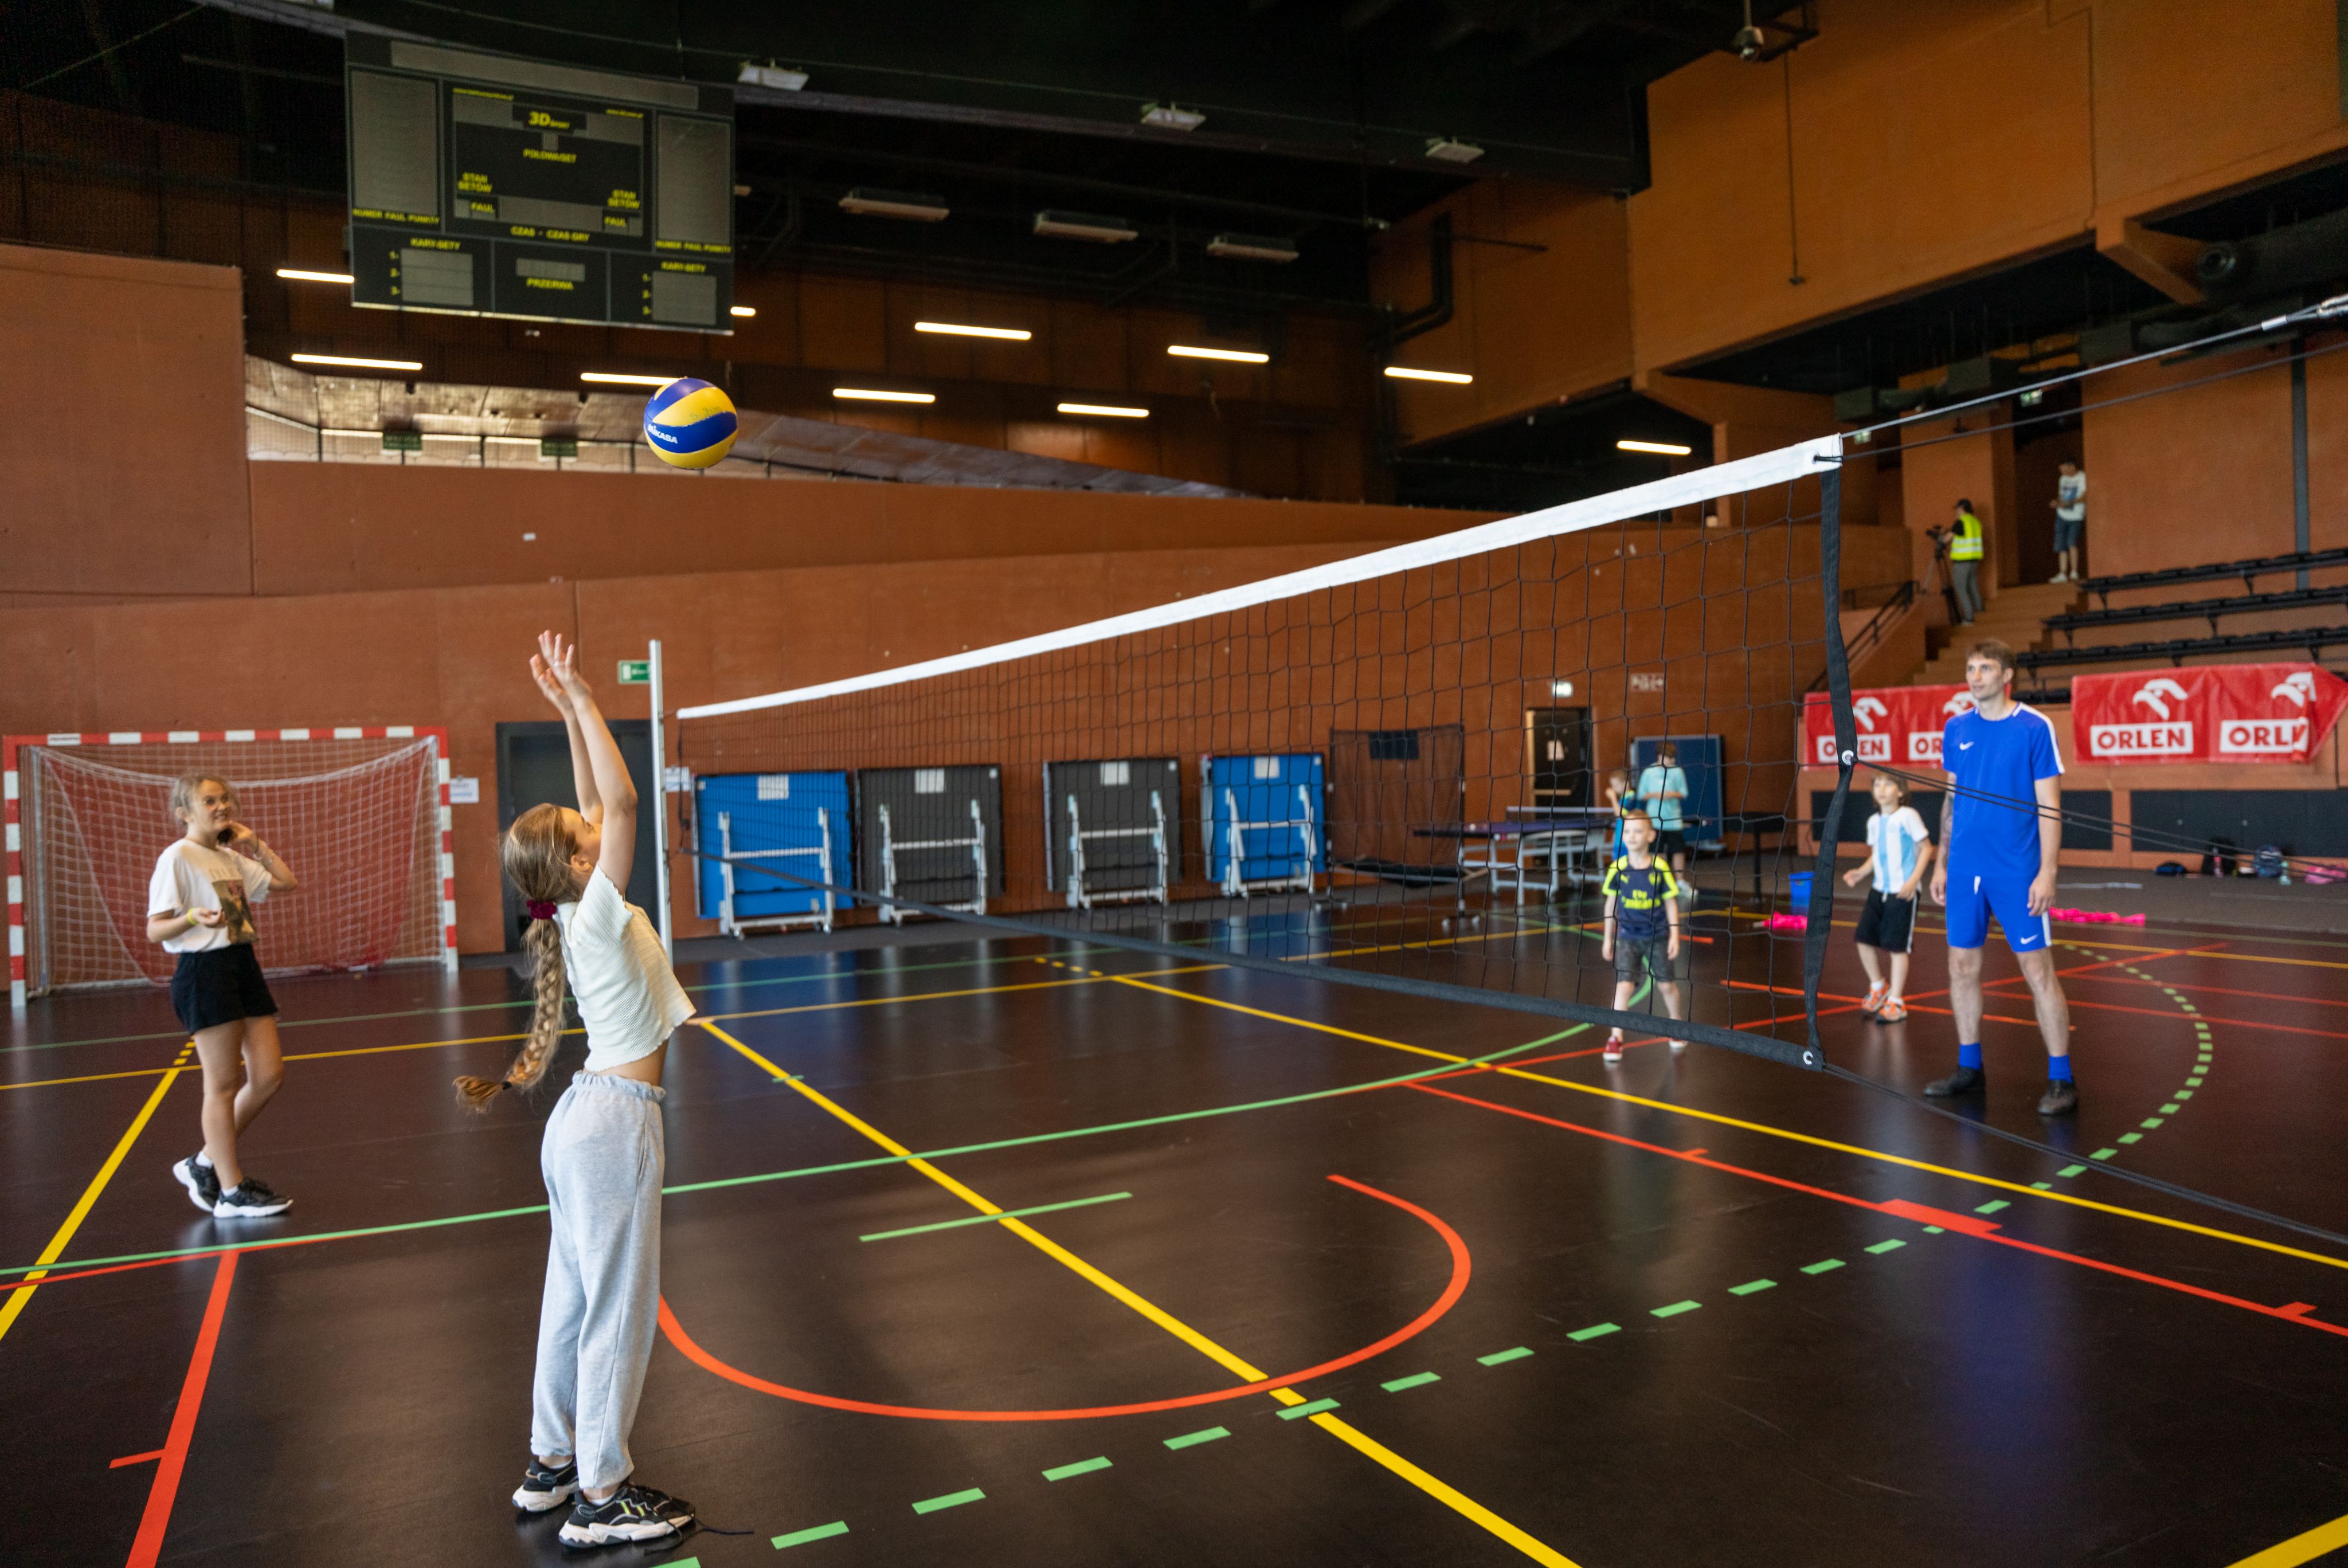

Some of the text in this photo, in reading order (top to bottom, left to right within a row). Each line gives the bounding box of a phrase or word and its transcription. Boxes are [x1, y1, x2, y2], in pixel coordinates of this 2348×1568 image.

[529, 111, 551, 127] 3D
[526, 277, 573, 290] PRZERWA
[2097, 727, 2185, 750] ORLEN
[1823, 739, 1884, 756] OEN
